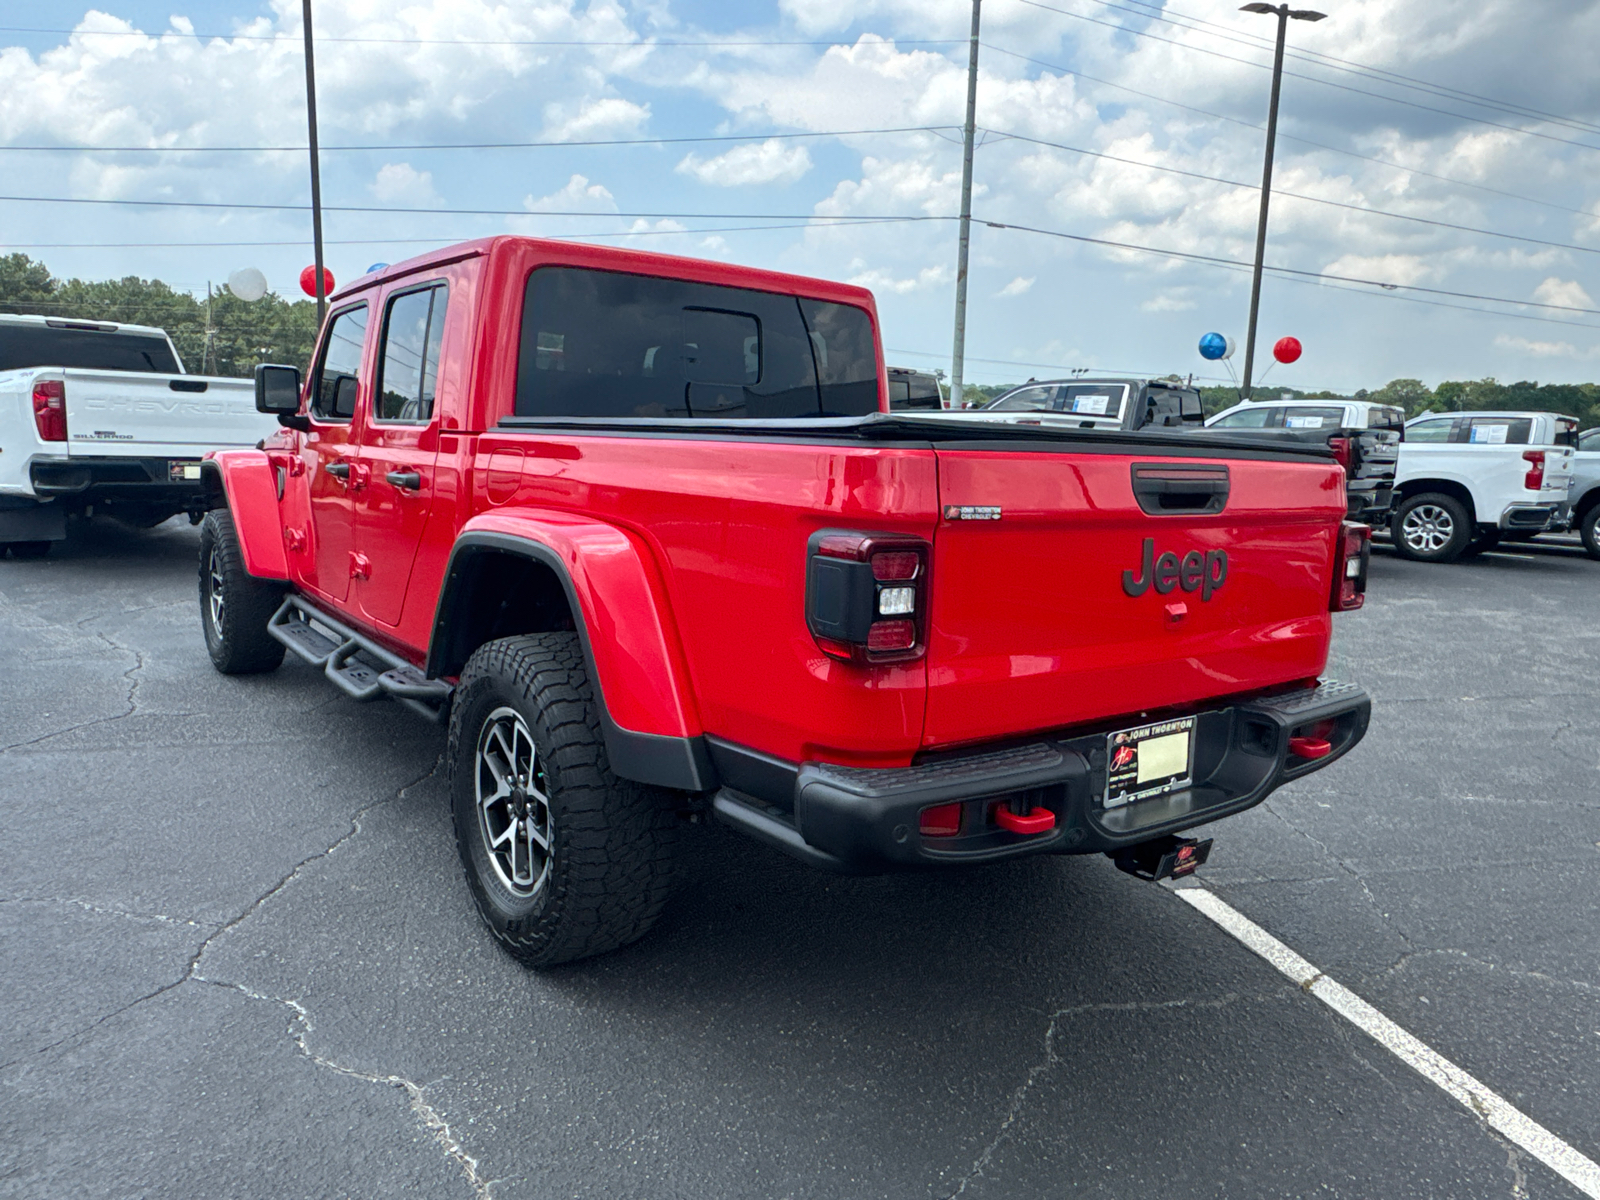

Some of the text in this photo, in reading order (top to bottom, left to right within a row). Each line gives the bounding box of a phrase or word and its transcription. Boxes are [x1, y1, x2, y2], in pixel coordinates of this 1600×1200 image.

[84, 397, 262, 416] CHEVROLE
[961, 506, 974, 514] JOHN
[1122, 537, 1228, 602] Jeep
[1130, 719, 1193, 740] JOHN THORNTON
